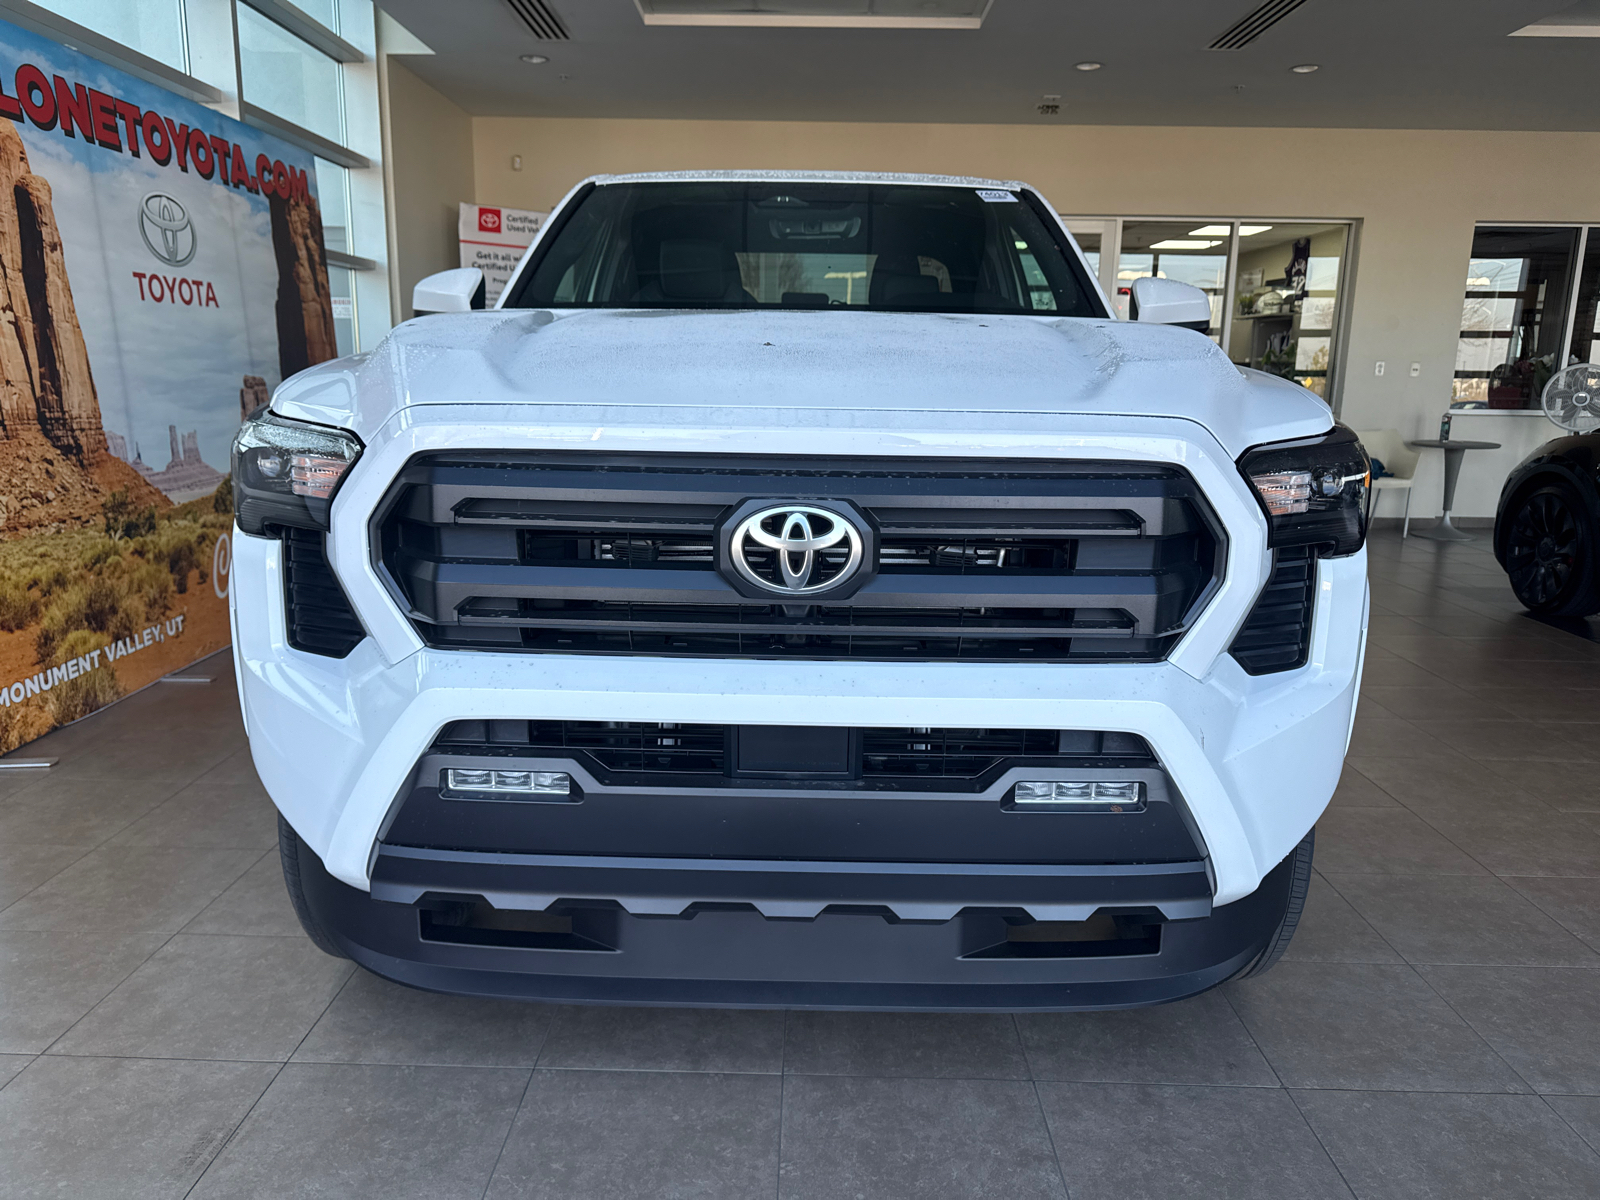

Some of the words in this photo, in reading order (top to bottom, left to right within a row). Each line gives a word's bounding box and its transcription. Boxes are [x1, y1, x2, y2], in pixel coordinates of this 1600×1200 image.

[506, 214, 538, 225] Certified
[506, 224, 526, 233] Used
[476, 250, 492, 261] Get
[493, 251, 499, 261] it
[501, 252, 511, 262] all
[471, 260, 508, 272] Certified
[132, 271, 219, 308] TOYOTA
[0, 648, 101, 708] MONUMENT
[103, 623, 165, 663] VALLEY,
[165, 615, 184, 637] UT
